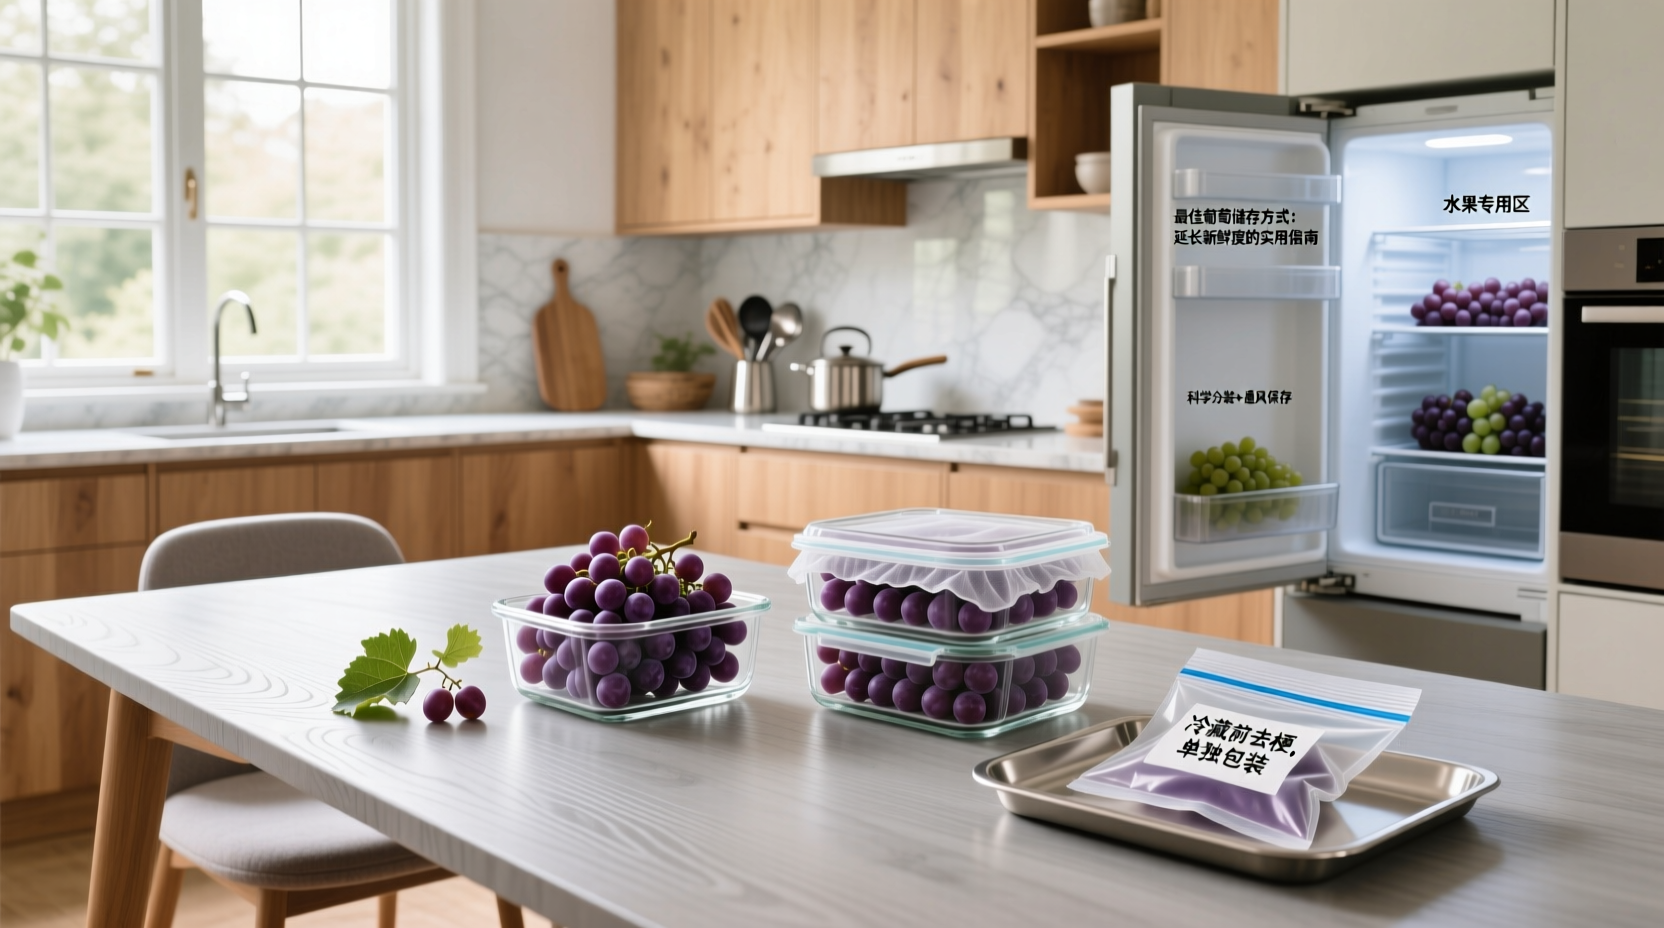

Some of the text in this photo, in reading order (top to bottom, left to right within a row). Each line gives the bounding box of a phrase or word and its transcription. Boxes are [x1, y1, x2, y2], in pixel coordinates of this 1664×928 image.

[1443, 194, 1531, 214] 水果专用区
[1176, 738, 1270, 775] 单独包装
